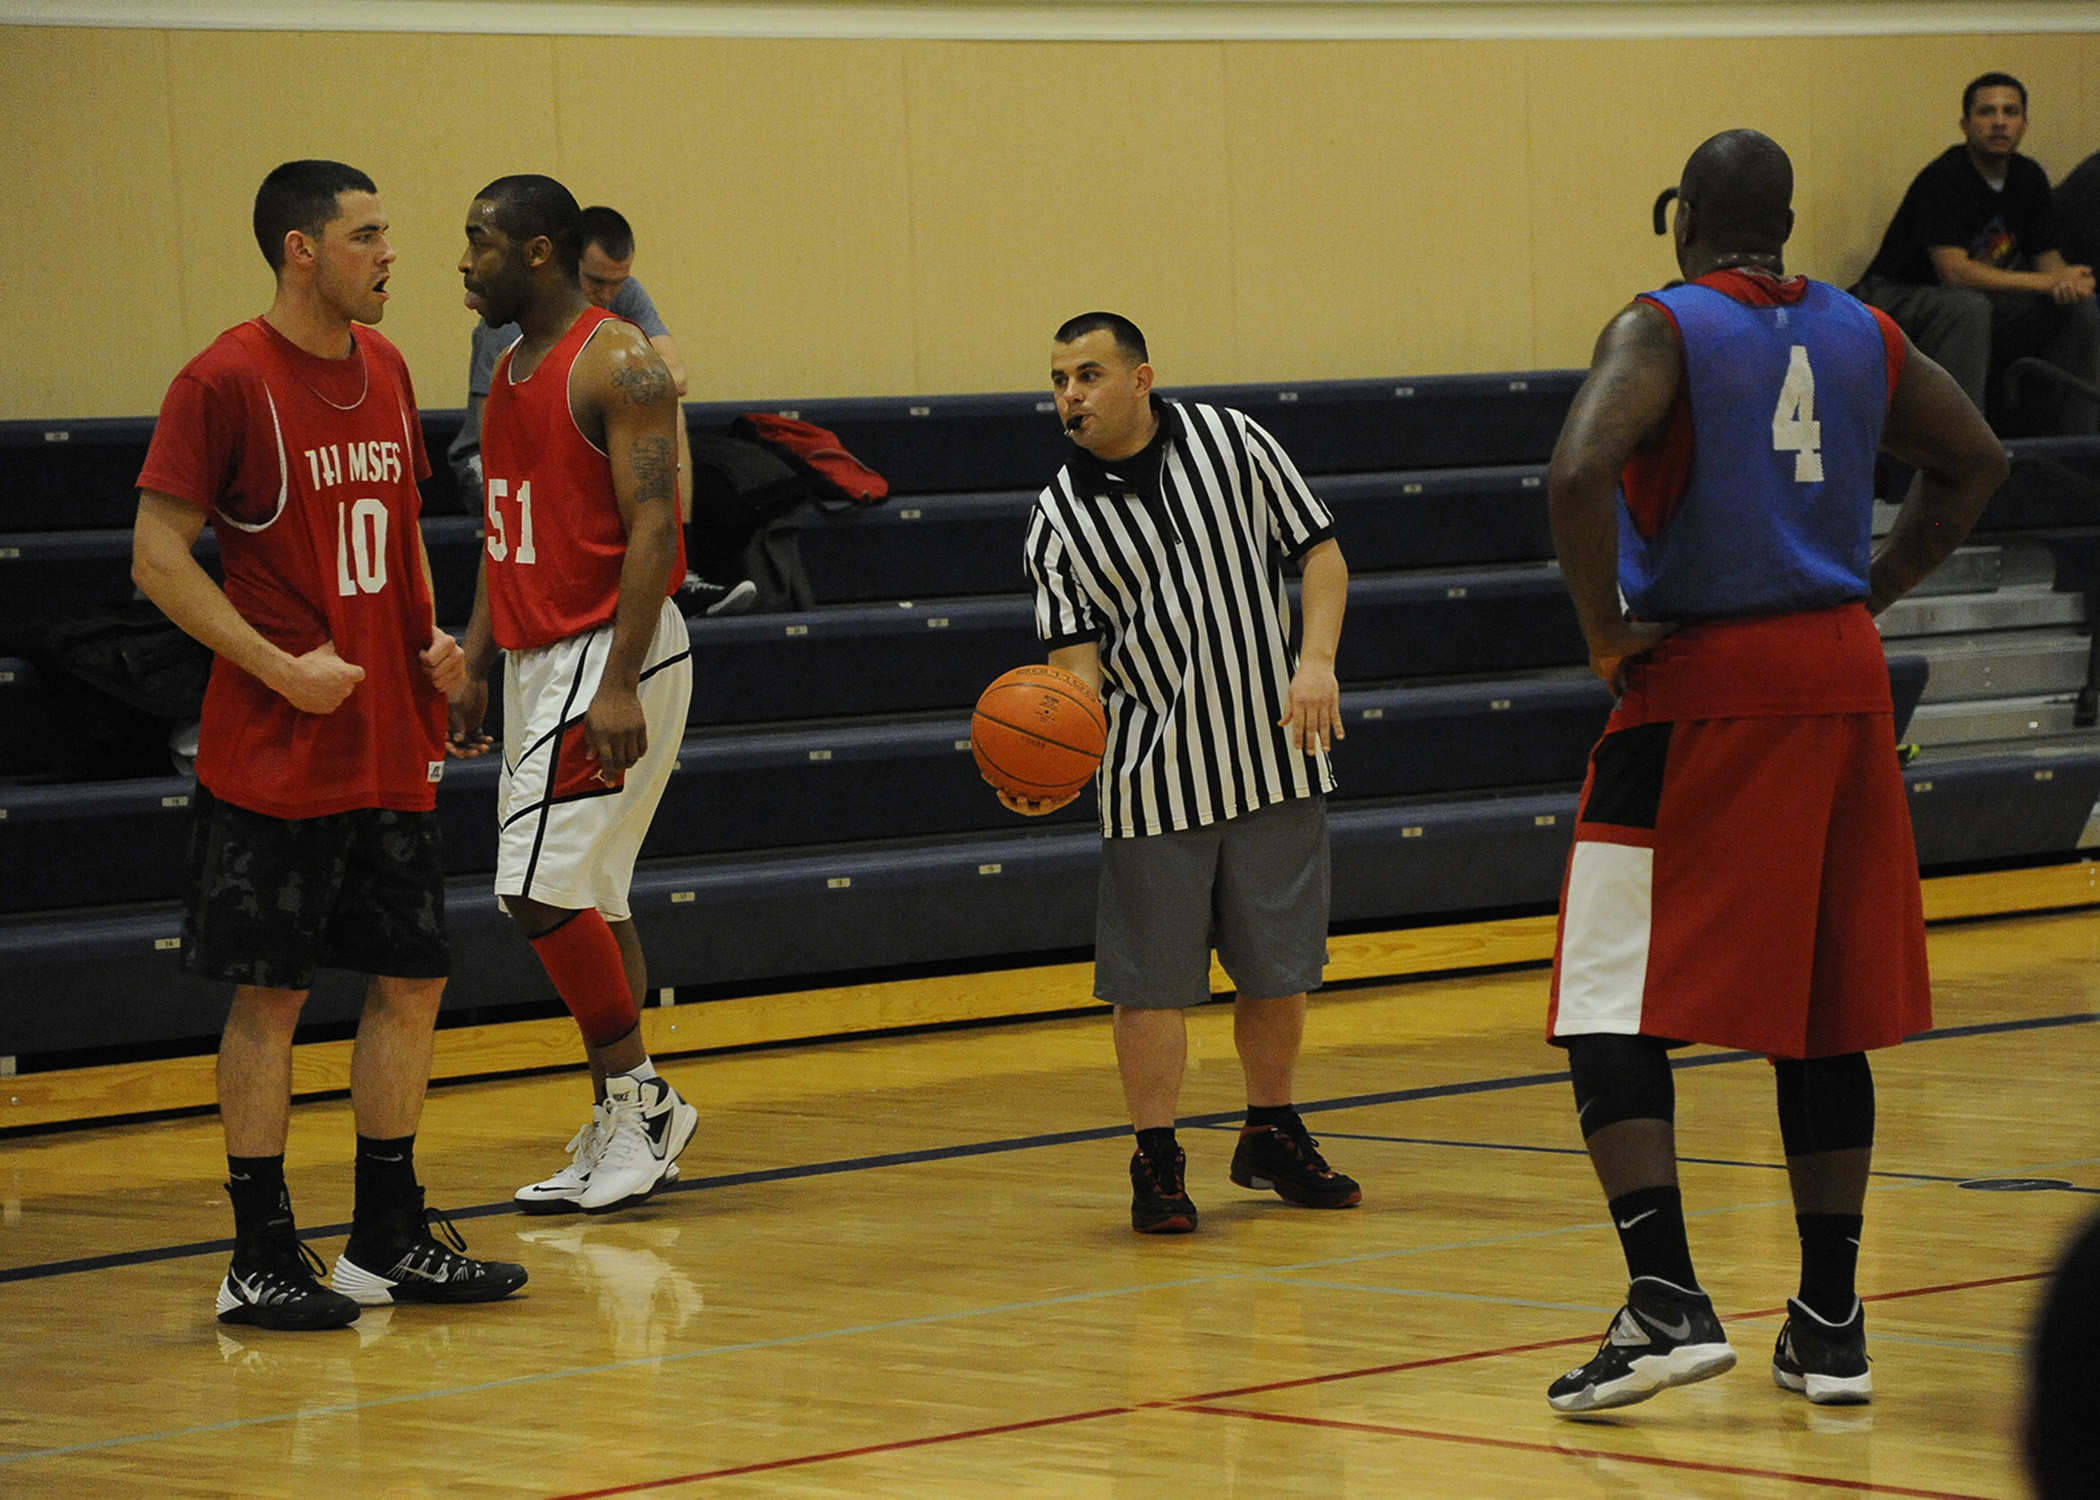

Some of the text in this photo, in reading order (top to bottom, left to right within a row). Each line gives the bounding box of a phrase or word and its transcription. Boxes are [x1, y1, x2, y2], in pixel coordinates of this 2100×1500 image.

[1772, 345, 1824, 482] 4
[348, 440, 402, 485] MSFS
[337, 498, 389, 597] 10
[487, 478, 536, 565] 51
